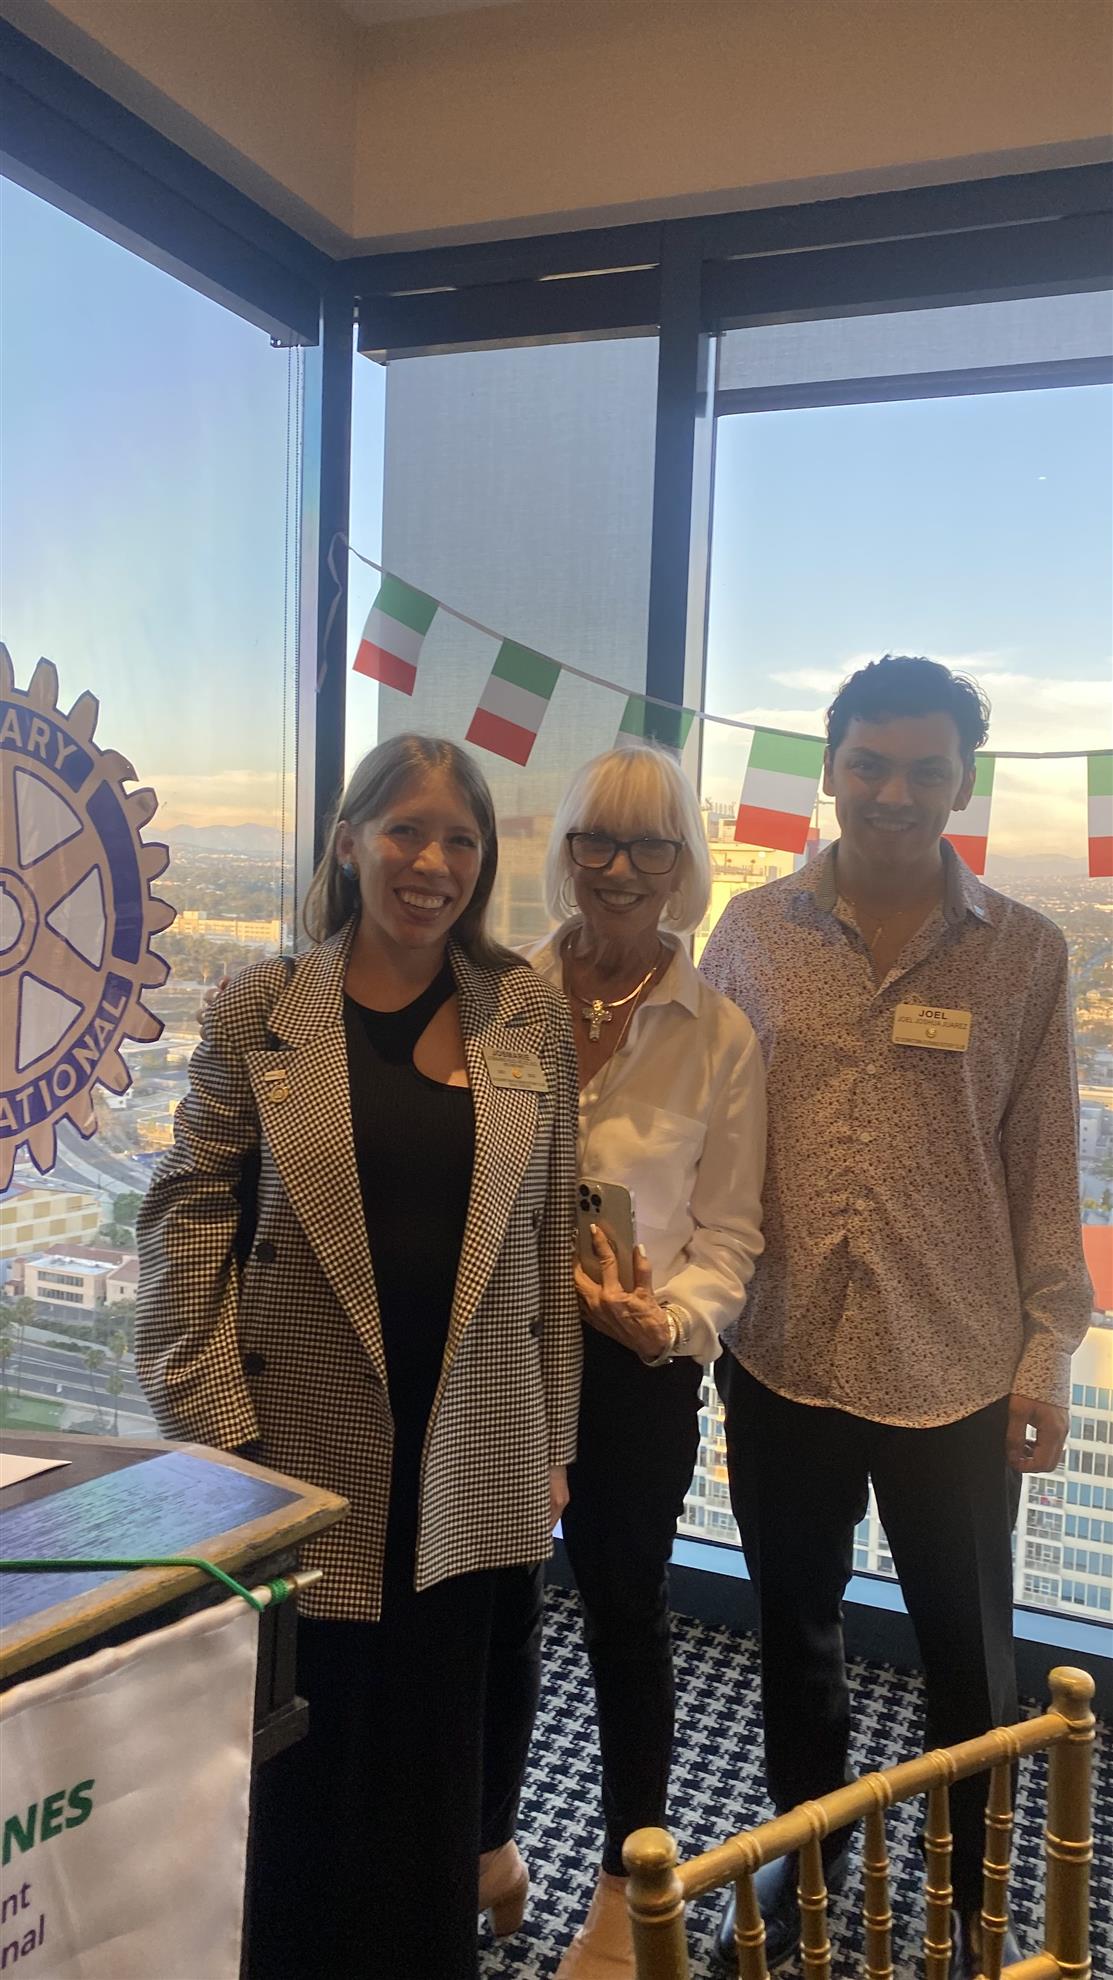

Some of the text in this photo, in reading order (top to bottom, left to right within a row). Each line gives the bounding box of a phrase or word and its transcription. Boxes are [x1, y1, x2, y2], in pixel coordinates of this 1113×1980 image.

[0, 707, 79, 770] ARY
[918, 1009, 949, 1020] JOEL
[1, 1778, 96, 1866] NES
